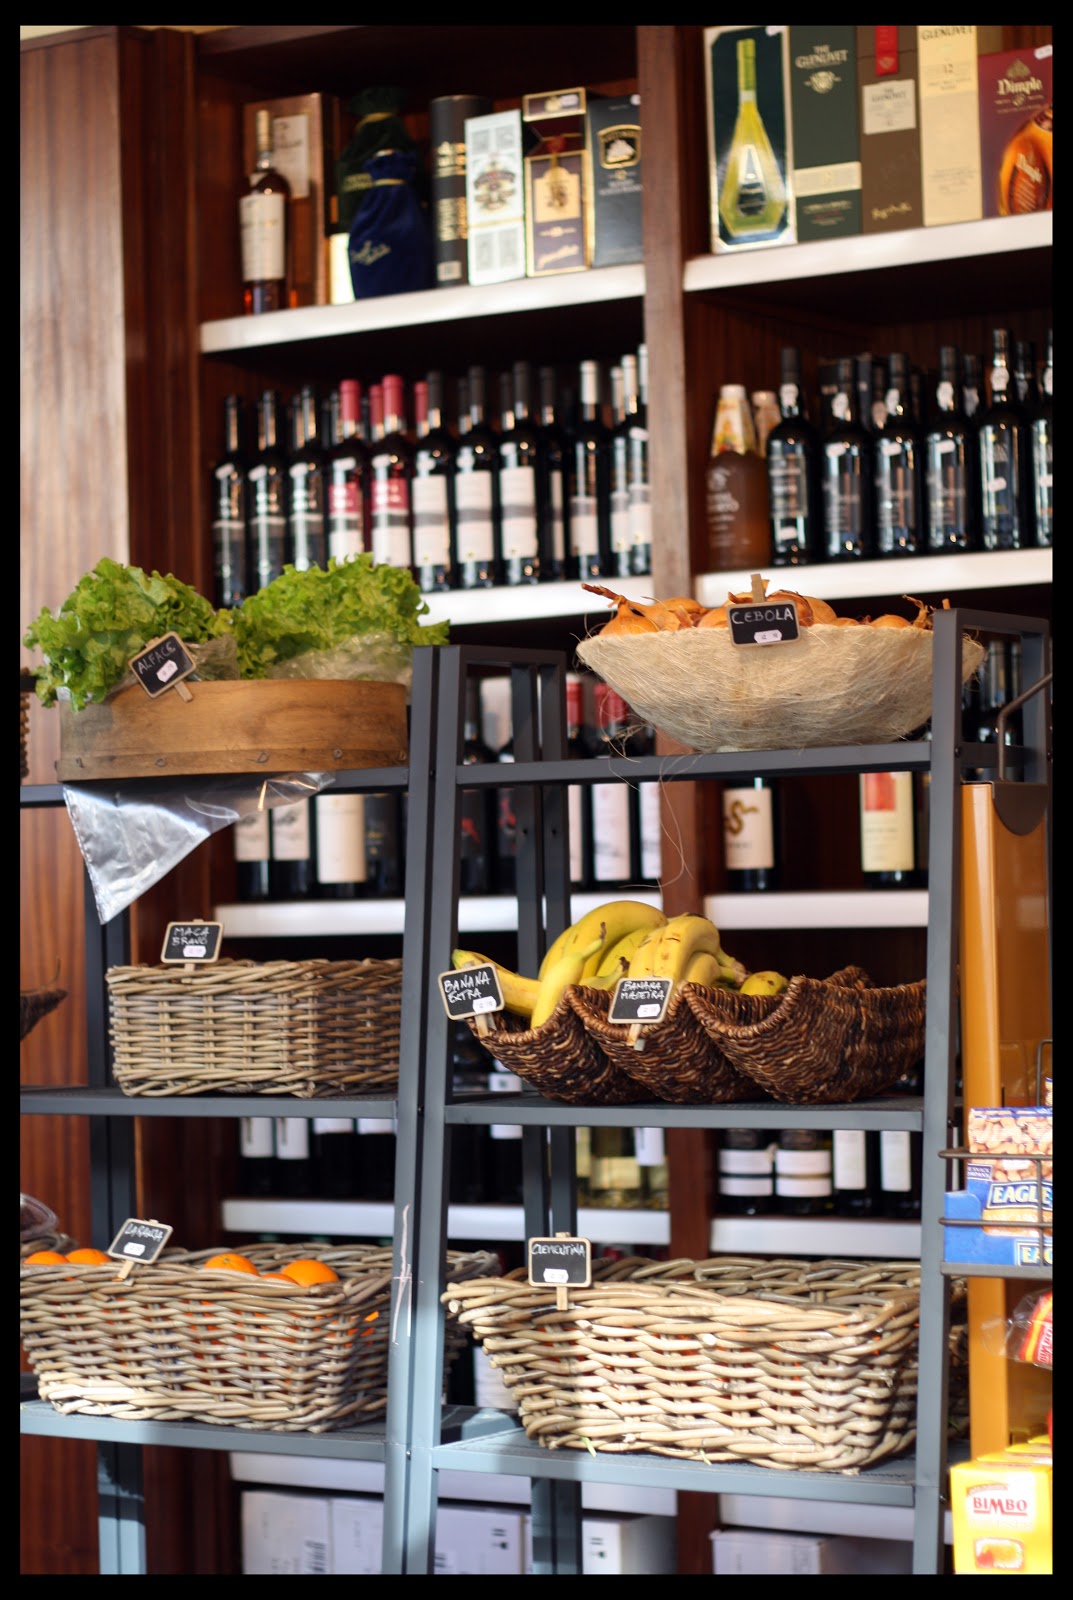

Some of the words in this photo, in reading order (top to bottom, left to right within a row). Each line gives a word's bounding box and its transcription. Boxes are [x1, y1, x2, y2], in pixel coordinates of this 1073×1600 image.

[795, 49, 849, 69] GLENLIVET
[997, 76, 1043, 96] Dimple
[731, 606, 795, 625] CEBOLA
[137, 640, 177, 675] ALFACE
[443, 970, 491, 993] BANANA
[621, 980, 662, 992] BANANA
[447, 987, 482, 1004] EXTRA
[620, 989, 666, 1001] MADEIRA
[993, 1185, 1053, 1204] EAGLE
[973, 1496, 1028, 1515] BIMBO
